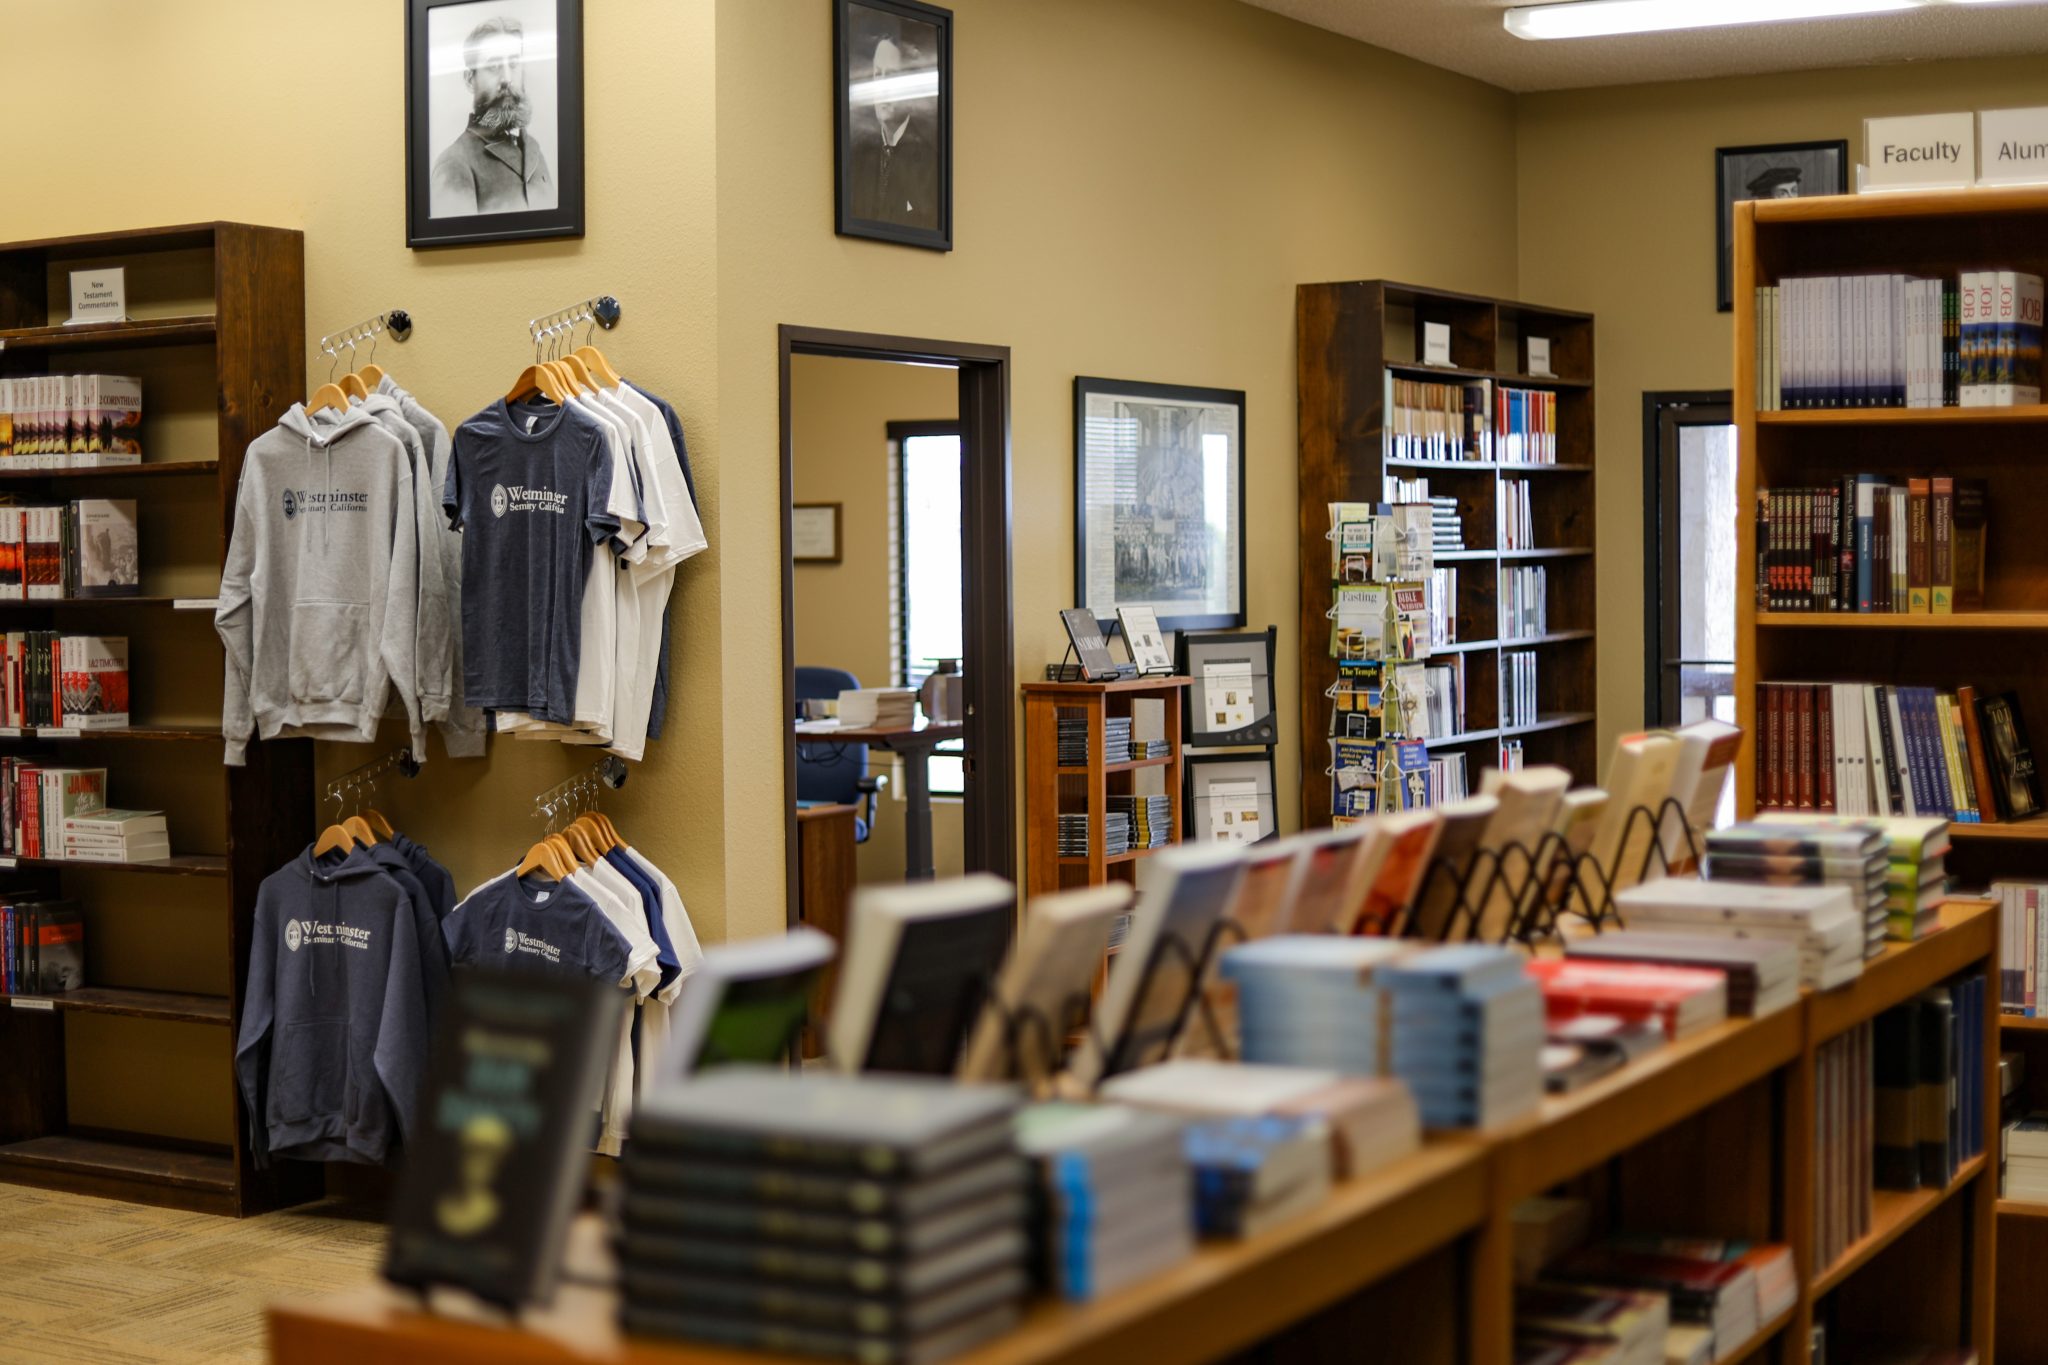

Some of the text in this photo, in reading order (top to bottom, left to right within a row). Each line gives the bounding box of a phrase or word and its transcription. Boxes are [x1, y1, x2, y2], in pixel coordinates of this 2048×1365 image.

[1883, 141, 1961, 164] Faculty
[78, 301, 118, 310] Commentaries
[83, 291, 113, 299] Testament
[1963, 286, 1975, 319] JOB
[1980, 284, 1992, 317] JOB
[2000, 284, 2012, 317] JOB
[2020, 297, 2042, 322] JOB
[1831, 497, 1840, 546] Stolen Identity
[1342, 591, 1377, 603] Fasting
[1397, 591, 1417, 603] BIBLE
[1341, 667, 1377, 678] The Temple
